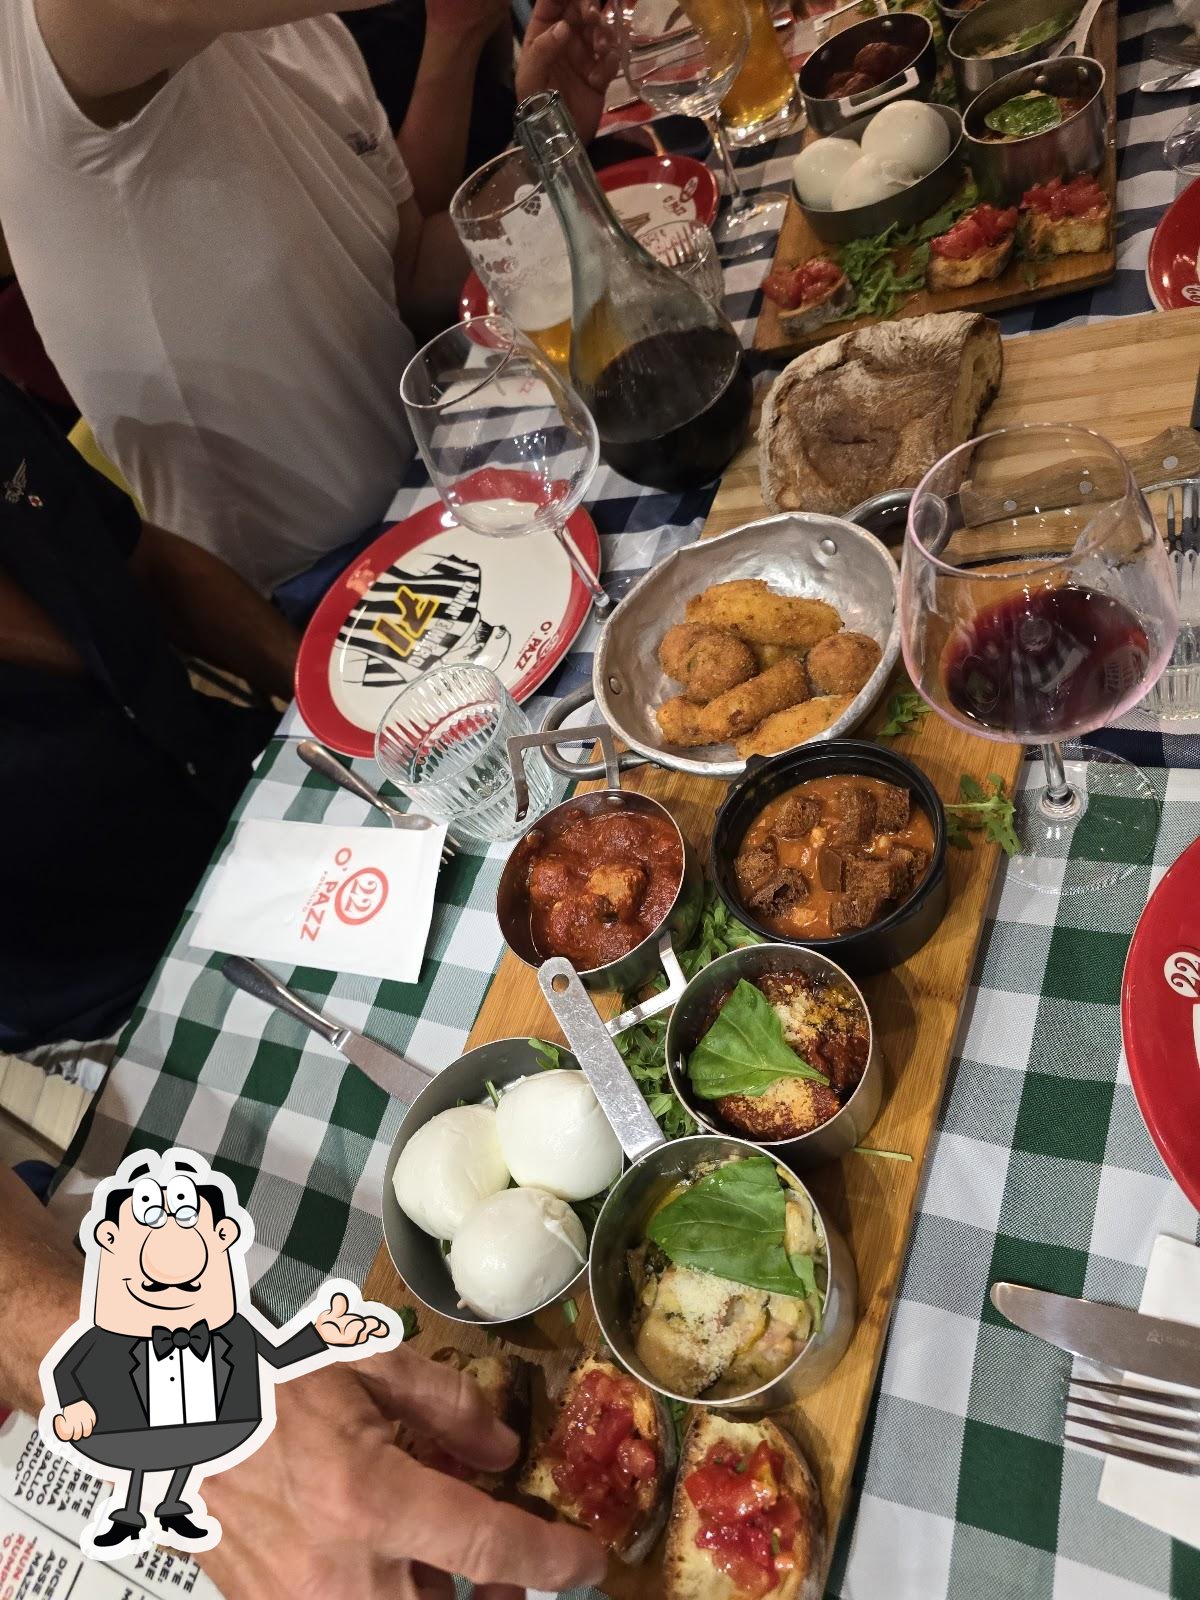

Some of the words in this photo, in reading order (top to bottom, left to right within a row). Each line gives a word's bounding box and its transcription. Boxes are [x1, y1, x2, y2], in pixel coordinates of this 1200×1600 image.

[372, 585, 441, 657] 71
[514, 638, 542, 671] PAZZ
[300, 881, 339, 941] PAZZ
[345, 879, 377, 912] 22
[47, 1460, 73, 1505] LLINA
[82, 1479, 103, 1519] ETTE
